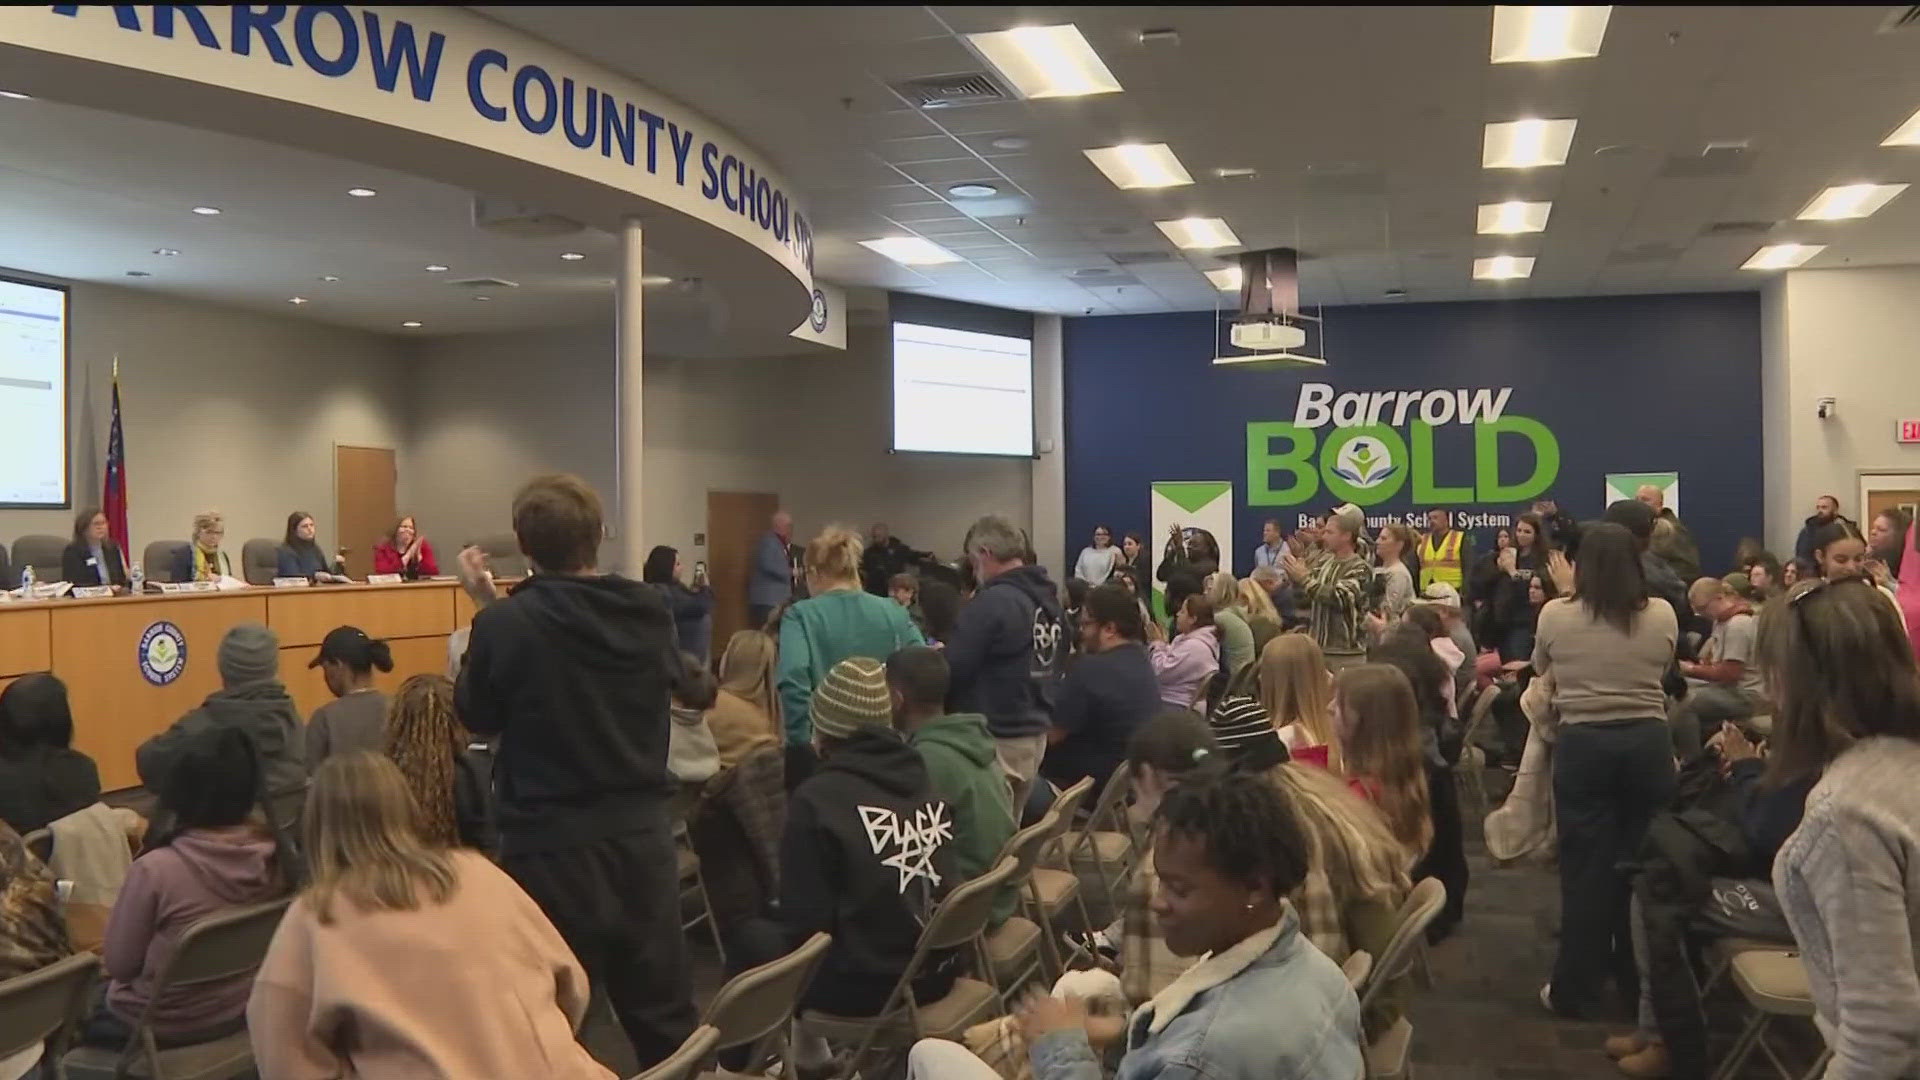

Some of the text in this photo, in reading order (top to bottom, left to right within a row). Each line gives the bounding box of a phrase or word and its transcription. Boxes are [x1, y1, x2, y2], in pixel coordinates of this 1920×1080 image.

[466, 48, 694, 187] COUNTY
[701, 142, 791, 243] SCHOOL
[1293, 382, 1512, 428] Barrow
[1246, 415, 1560, 507] BOLD
[1406, 511, 1453, 529] Schl
[1458, 511, 1510, 530] System
